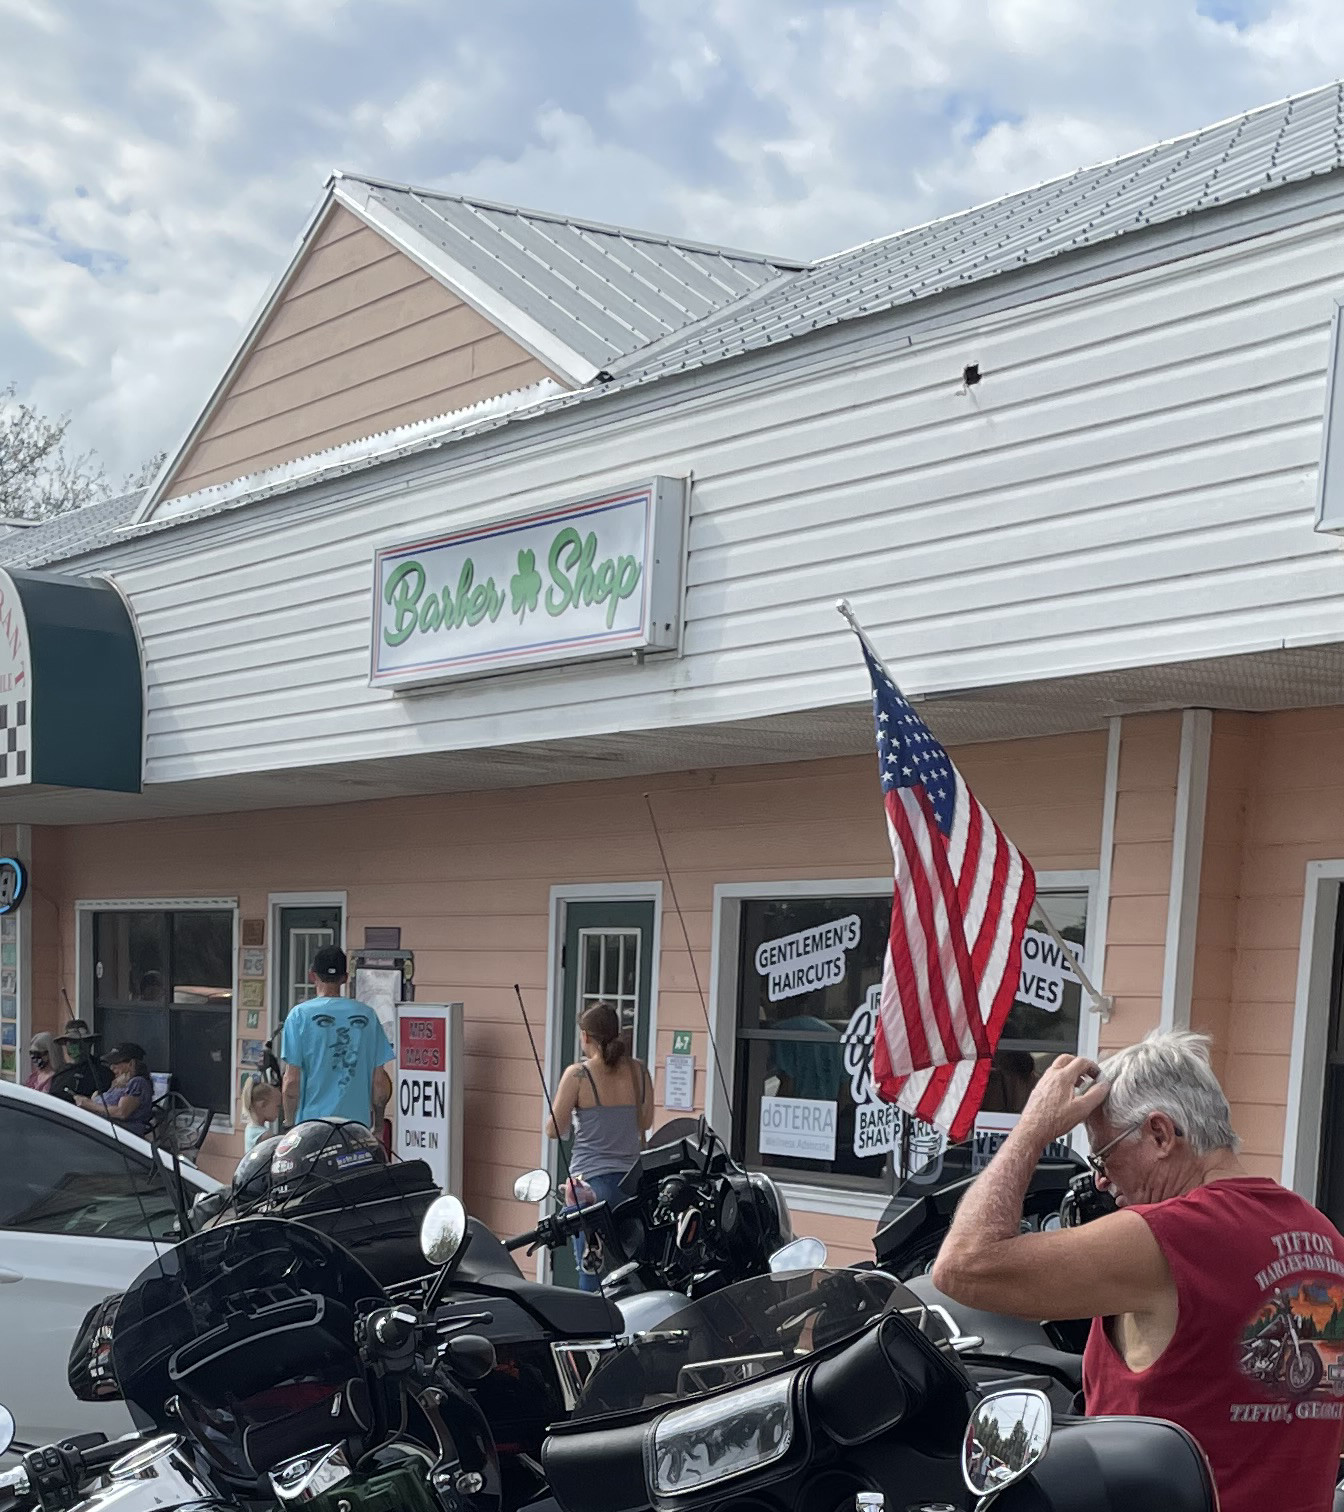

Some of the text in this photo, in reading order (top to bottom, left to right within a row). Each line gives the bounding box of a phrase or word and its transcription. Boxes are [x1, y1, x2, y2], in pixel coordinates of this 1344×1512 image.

[384, 527, 643, 647] Barber Shop
[759, 921, 856, 968] GENTLEMEN'S
[772, 957, 841, 994] HAIRCUTS
[674, 1036, 690, 1050] A-7
[400, 1079, 445, 1119] OPEN
[405, 1129, 439, 1149] DINE IN
[1271, 1231, 1334, 1256] TIFTON
